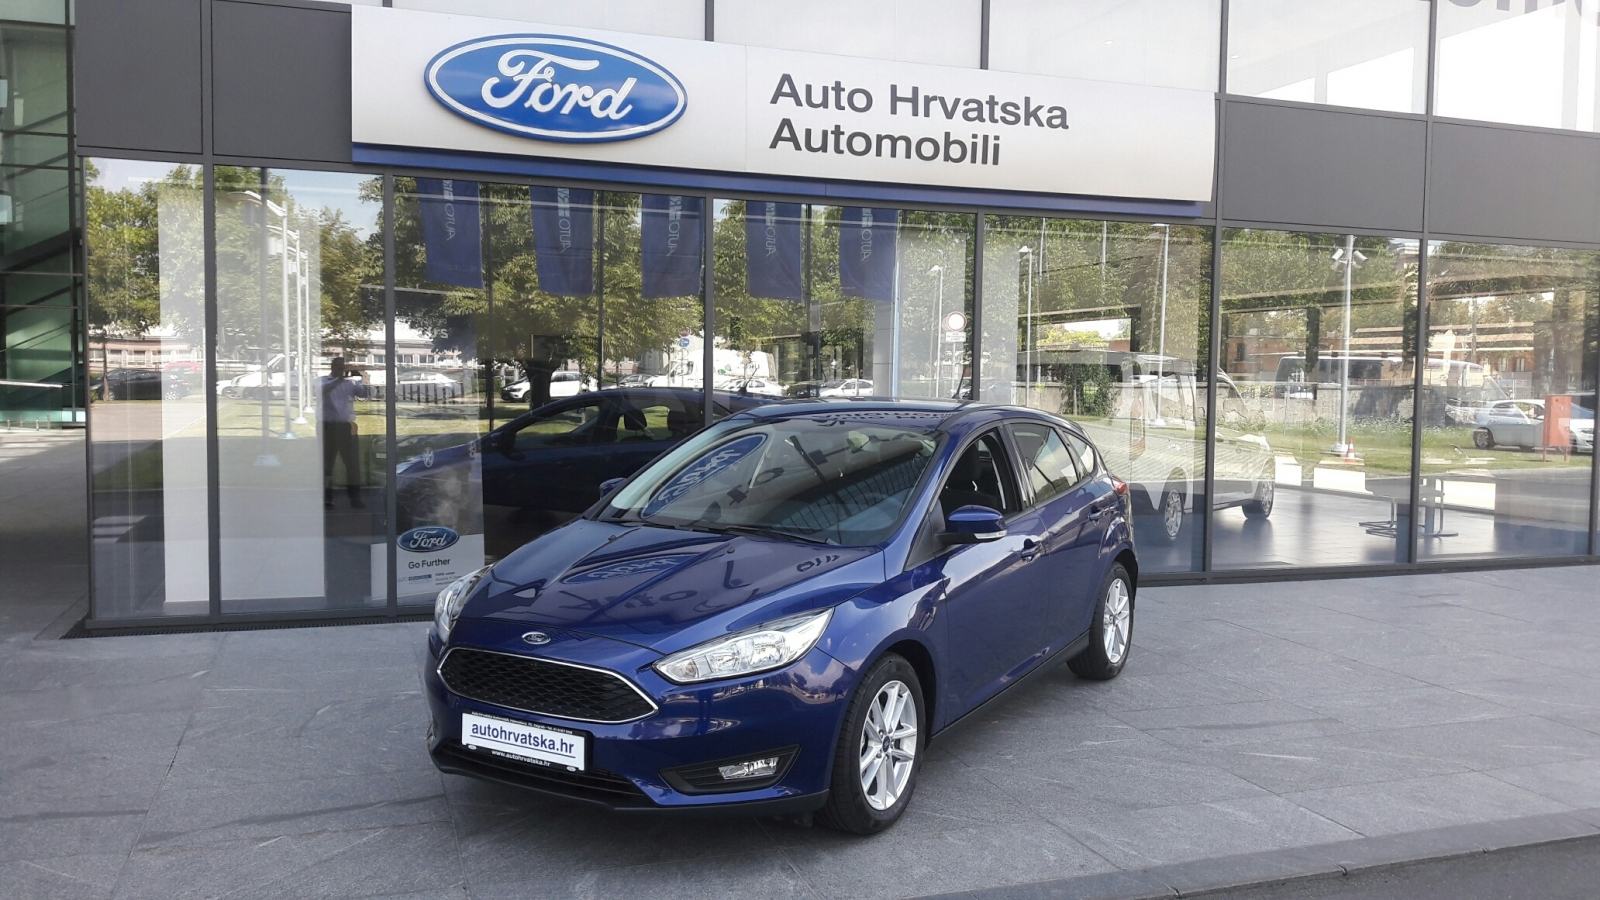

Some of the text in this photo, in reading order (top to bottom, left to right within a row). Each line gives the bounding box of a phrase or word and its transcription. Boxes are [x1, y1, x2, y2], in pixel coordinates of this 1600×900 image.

[481, 49, 637, 120] Ford
[769, 73, 1069, 130] Auto Hrvatska
[769, 118, 1000, 166] Automobili
[409, 530, 447, 548] Ford
[408, 558, 451, 569] Go Further
[471, 723, 575, 754] autohrvatska.hr
